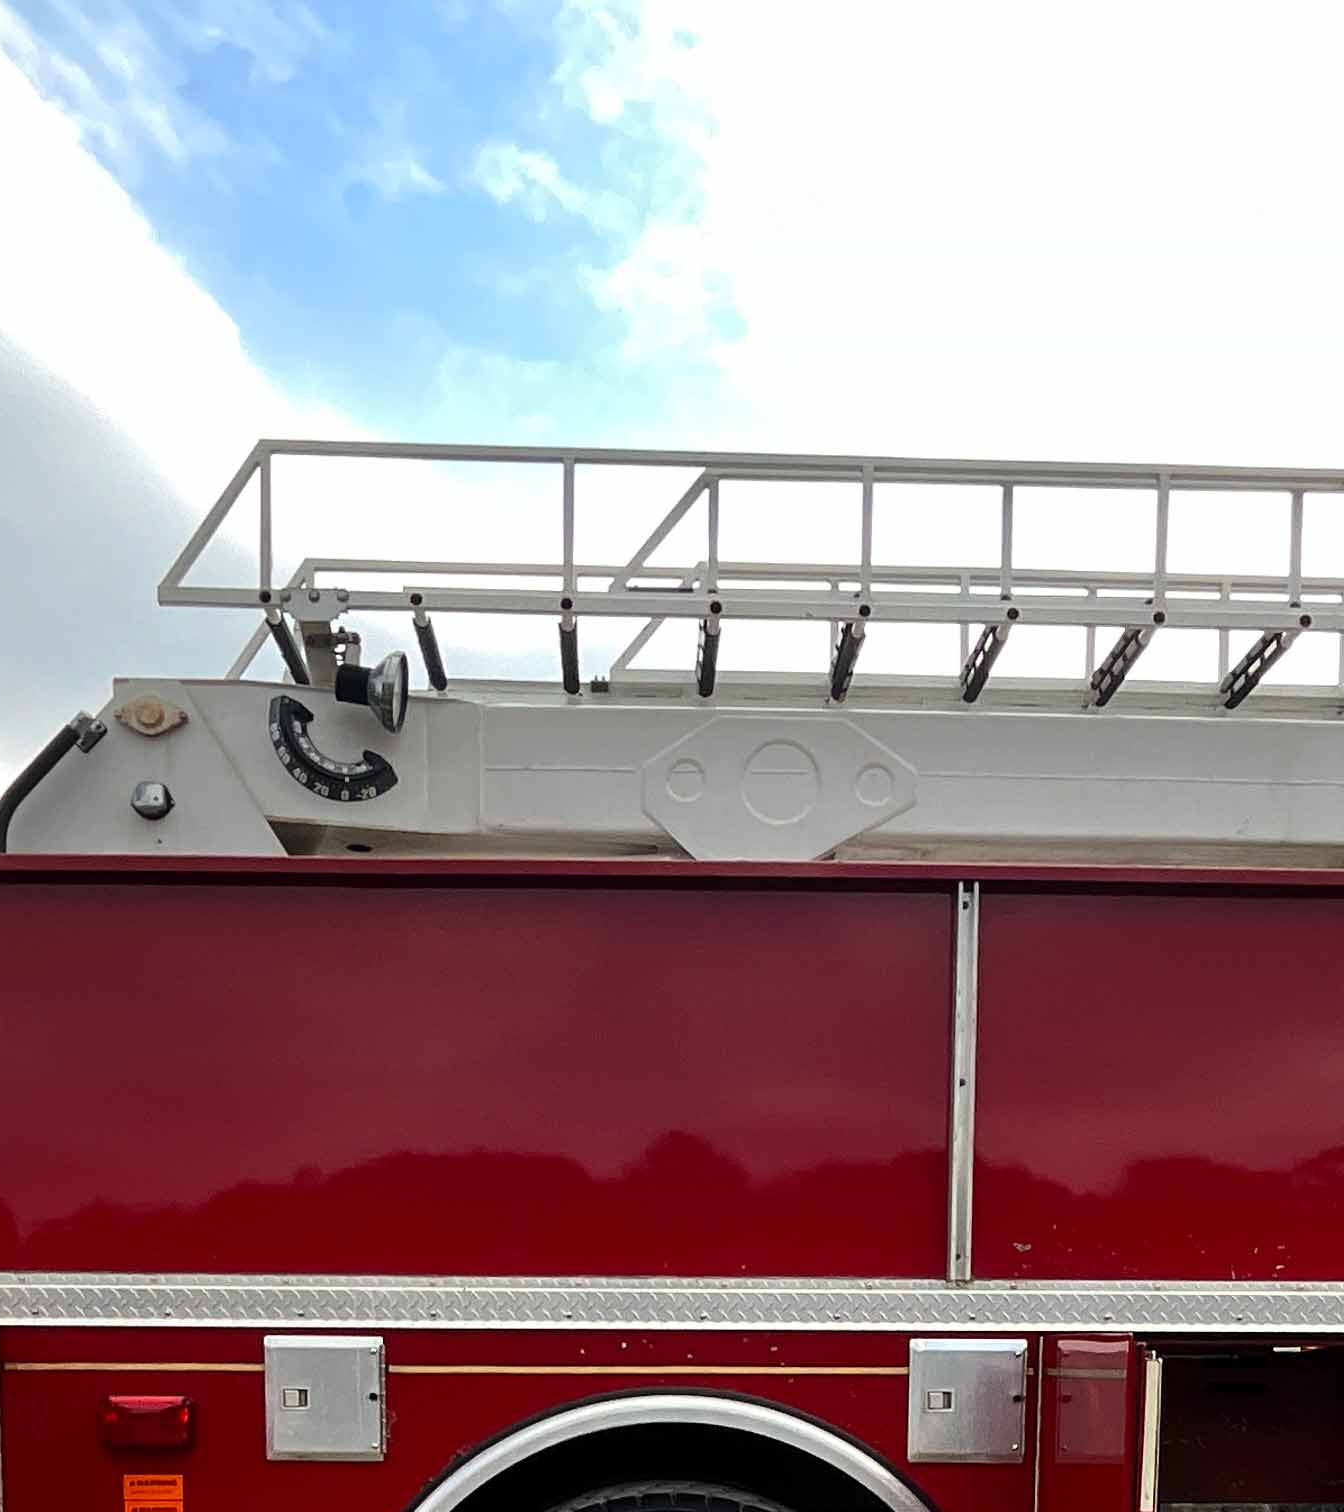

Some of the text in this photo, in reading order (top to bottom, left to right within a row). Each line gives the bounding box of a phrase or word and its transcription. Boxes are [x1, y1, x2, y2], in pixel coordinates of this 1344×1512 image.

[293, 767, 308, 783] 40
[313, 782, 329, 796] 20
[341, 790, 350, 801] 0
